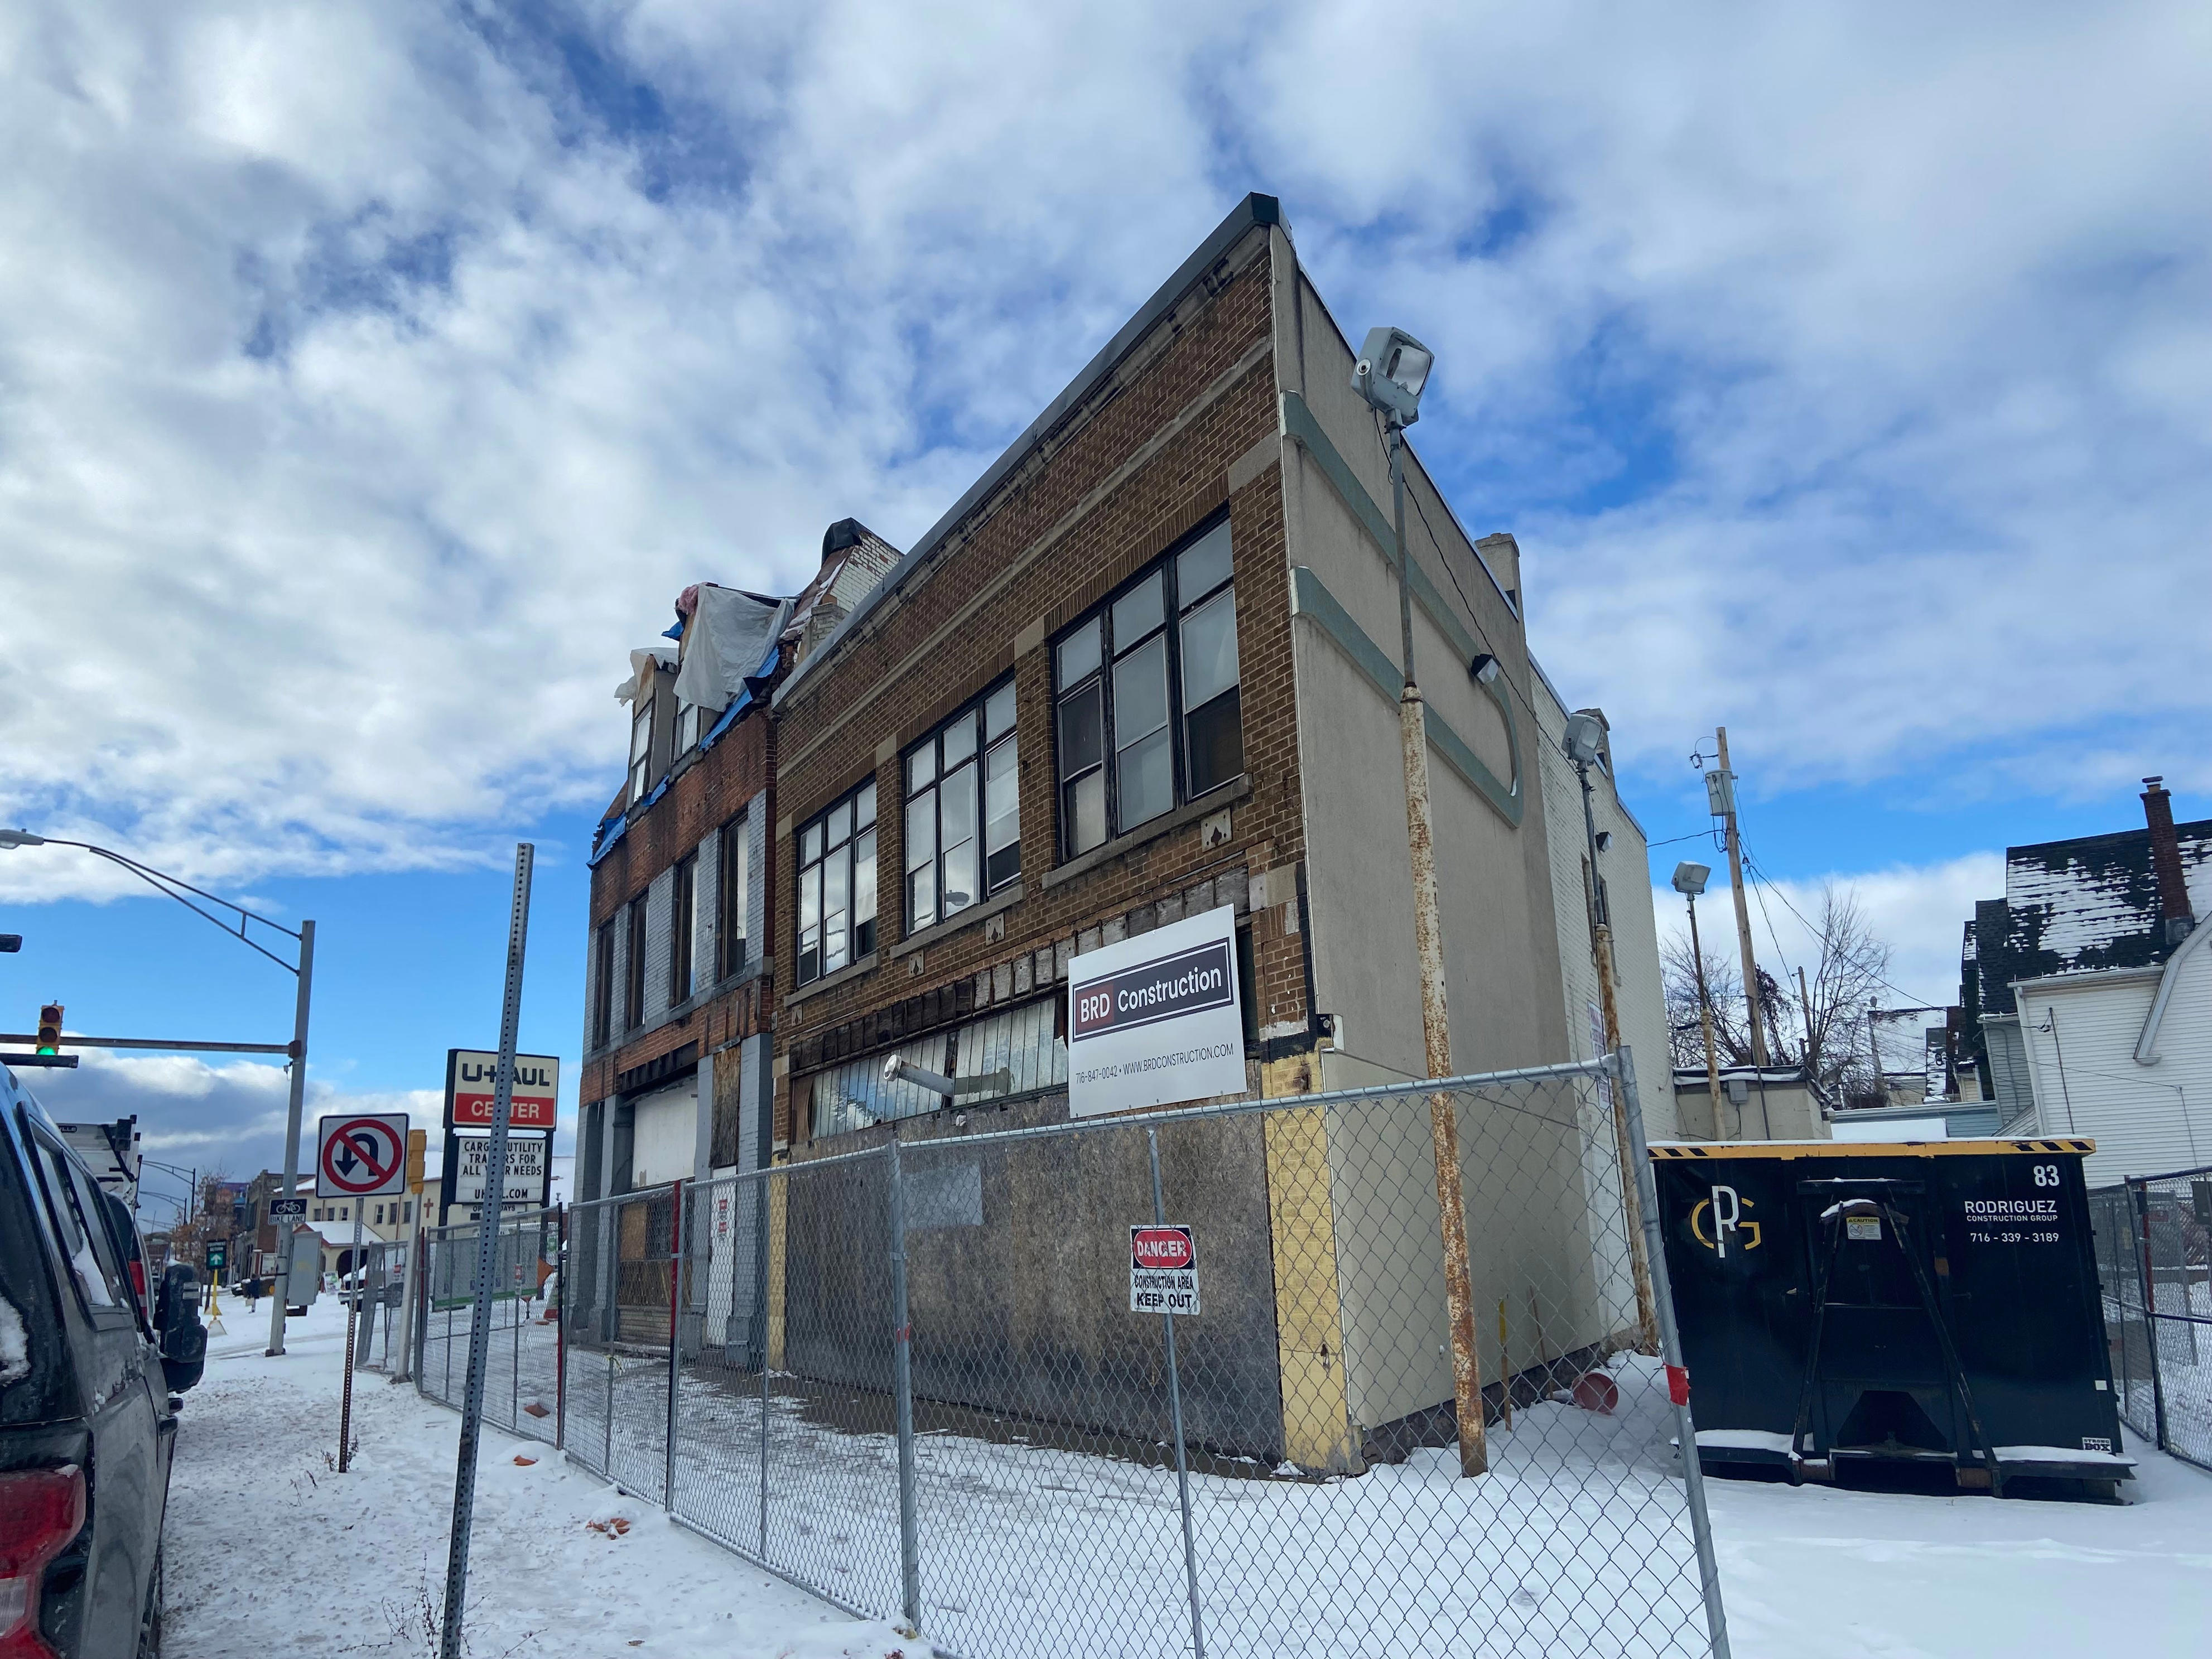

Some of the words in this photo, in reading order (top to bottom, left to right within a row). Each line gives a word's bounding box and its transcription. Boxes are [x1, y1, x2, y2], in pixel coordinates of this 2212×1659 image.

[1081, 992, 1111, 1023] BRD
[1117, 966, 1222, 1012] Construction
[1076, 1065, 1117, 1084] 716-847-0042
[1122, 1043, 1234, 1076] WWW.BRDCONSTRUCTION.COM
[471, 1100, 539, 1118] CETER
[464, 1141, 489, 1151] CARG
[507, 1142, 542, 1152] UTILITY
[470, 1154, 515, 1164] TRARS
[519, 1154, 536, 1164] FOR
[462, 1165, 480, 1175] ALL
[514, 1165, 542, 1175] NEEDS
[2033, 1165, 2060, 1187] 83
[1964, 1200, 2057, 1213] RODRIGUEZ
[1136, 1240, 1187, 1257] DANGER
[1134, 1275, 1175, 1289] CONSTRUCTION
[1178, 1276, 1194, 1289] AREA
[1137, 1293, 1164, 1306] KEEP
[1168, 1293, 1192, 1308] OUT
